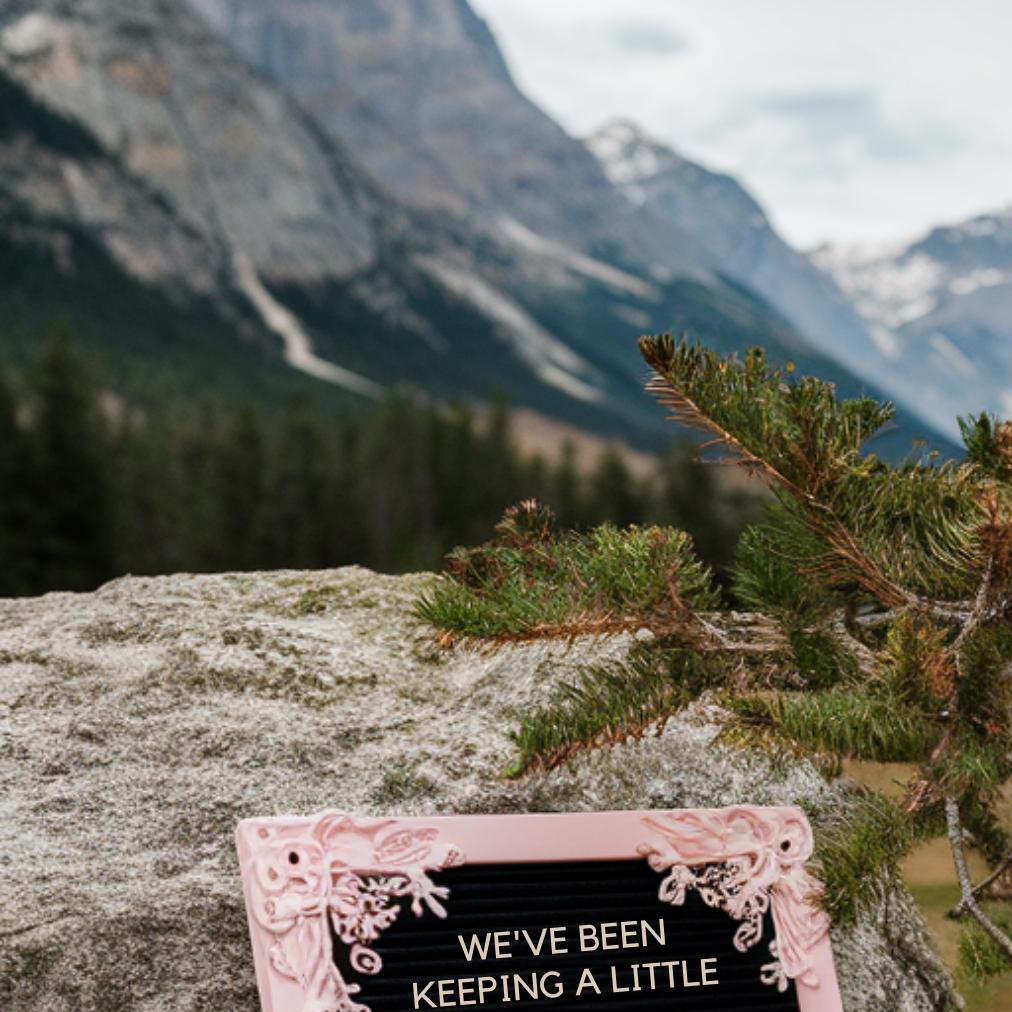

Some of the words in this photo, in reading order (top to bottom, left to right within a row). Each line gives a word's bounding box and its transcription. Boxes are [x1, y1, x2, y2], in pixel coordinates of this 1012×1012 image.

[458, 927, 568, 961] WE'VE
[579, 919, 665, 951] BEEN
[413, 971, 563, 1009] KEEPING
[576, 969, 601, 995] A
[611, 958, 718, 992] LITTLE
